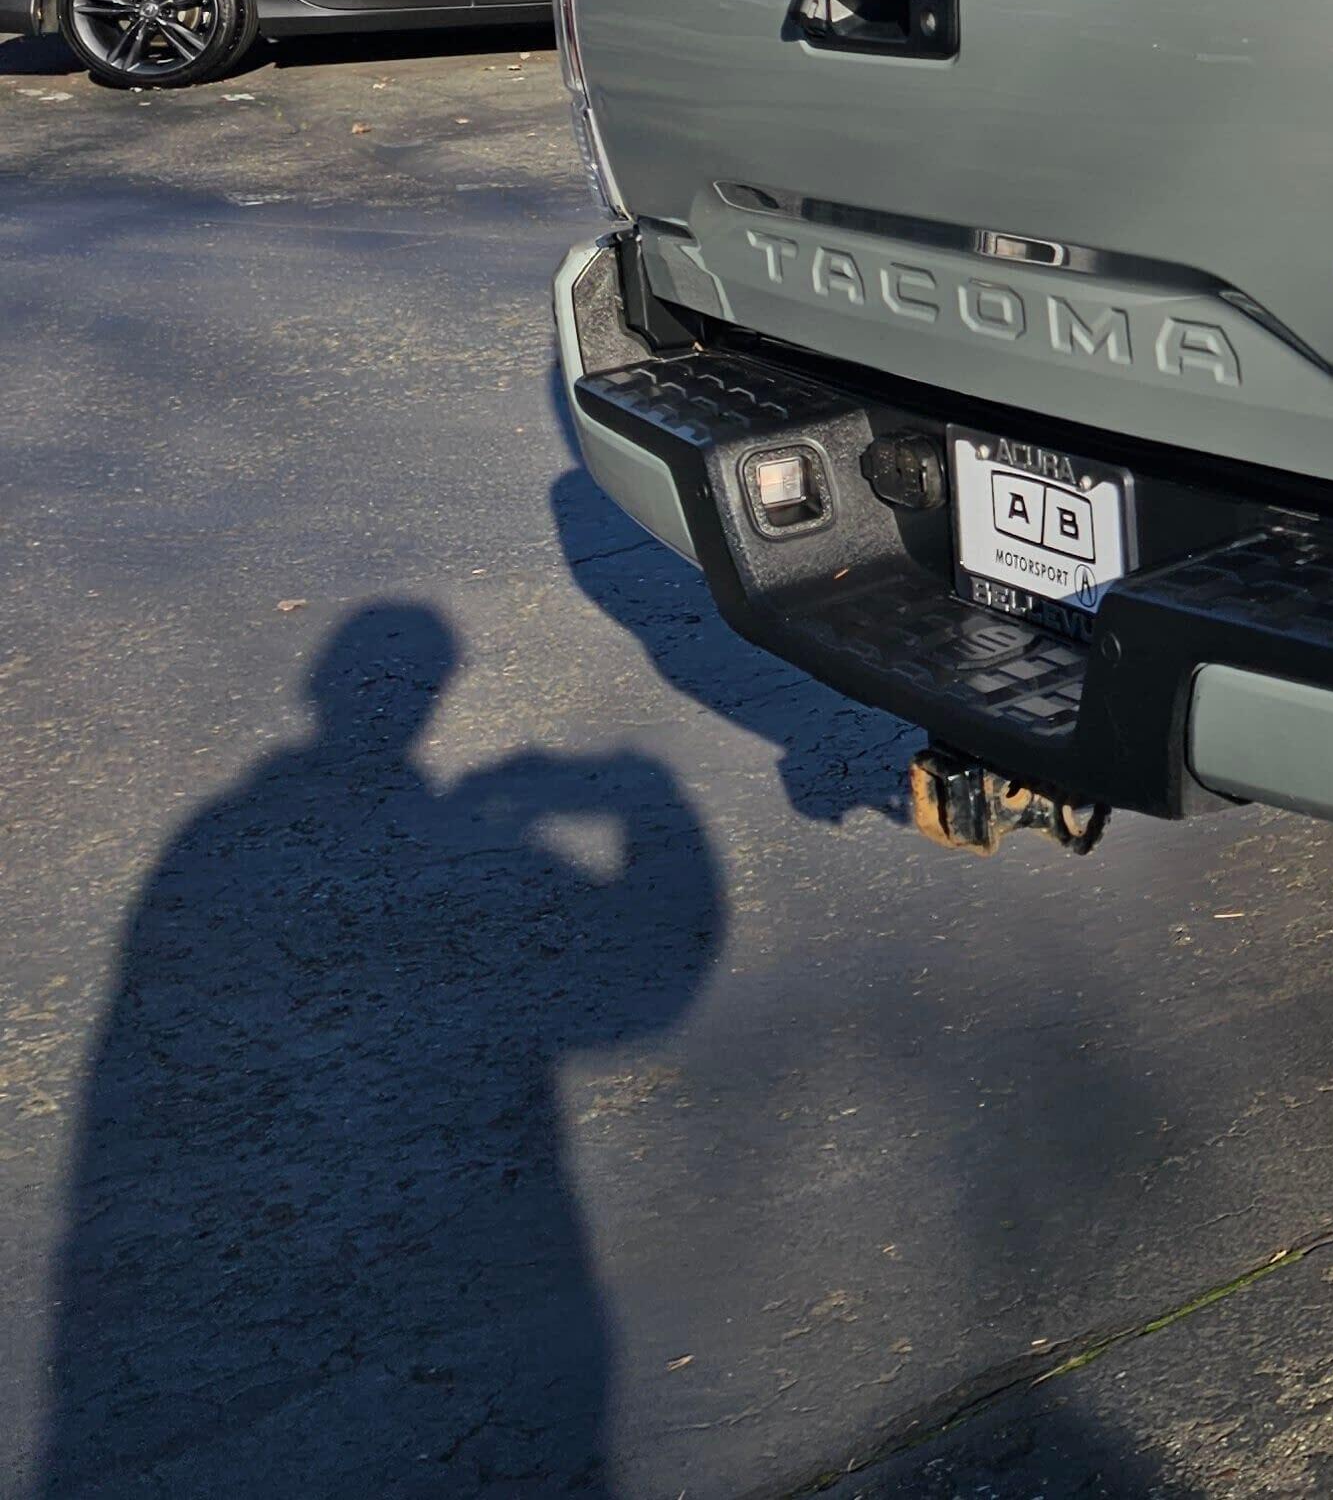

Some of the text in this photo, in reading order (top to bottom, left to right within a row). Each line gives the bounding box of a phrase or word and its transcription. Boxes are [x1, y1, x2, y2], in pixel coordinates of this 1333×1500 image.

[745, 228, 1243, 387] TACOMA
[1008, 491, 1080, 541] A B
[995, 549, 1069, 587] MOTORSPORT
